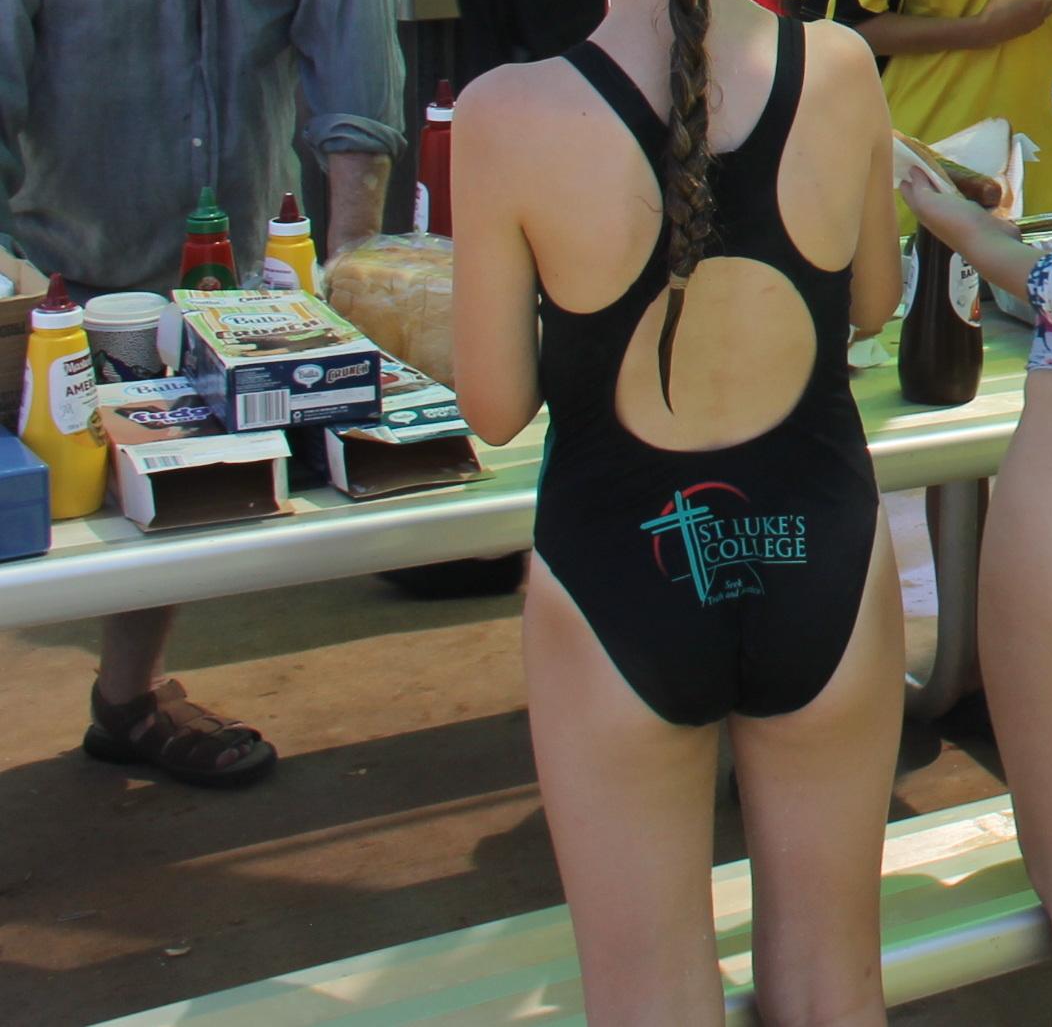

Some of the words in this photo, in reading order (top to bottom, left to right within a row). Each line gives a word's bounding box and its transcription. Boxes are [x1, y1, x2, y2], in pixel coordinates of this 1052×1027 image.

[231, 314, 290, 325] Bulla
[326, 362, 371, 384] CRUNCH
[131, 381, 194, 395] Bulla
[699, 519, 725, 543] ST
[733, 515, 805, 536] LUKE'S
[704, 537, 807, 563] COLLEGE
